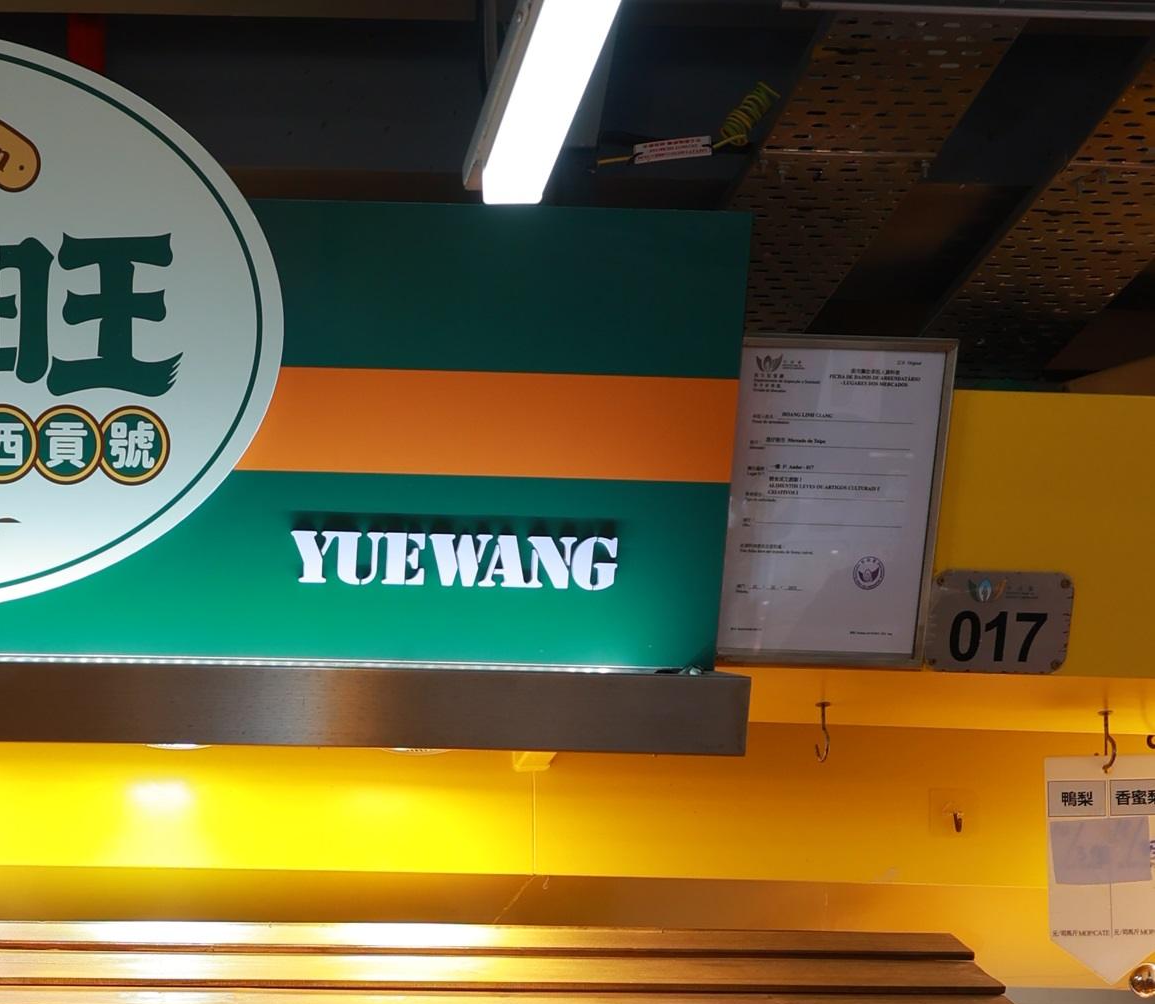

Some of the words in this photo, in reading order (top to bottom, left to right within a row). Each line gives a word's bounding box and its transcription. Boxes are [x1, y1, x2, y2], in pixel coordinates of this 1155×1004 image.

[290, 529, 619, 592] YUEWANG
[949, 610, 1048, 662] 017
[1061, 791, 1093, 807] 鴨梨
